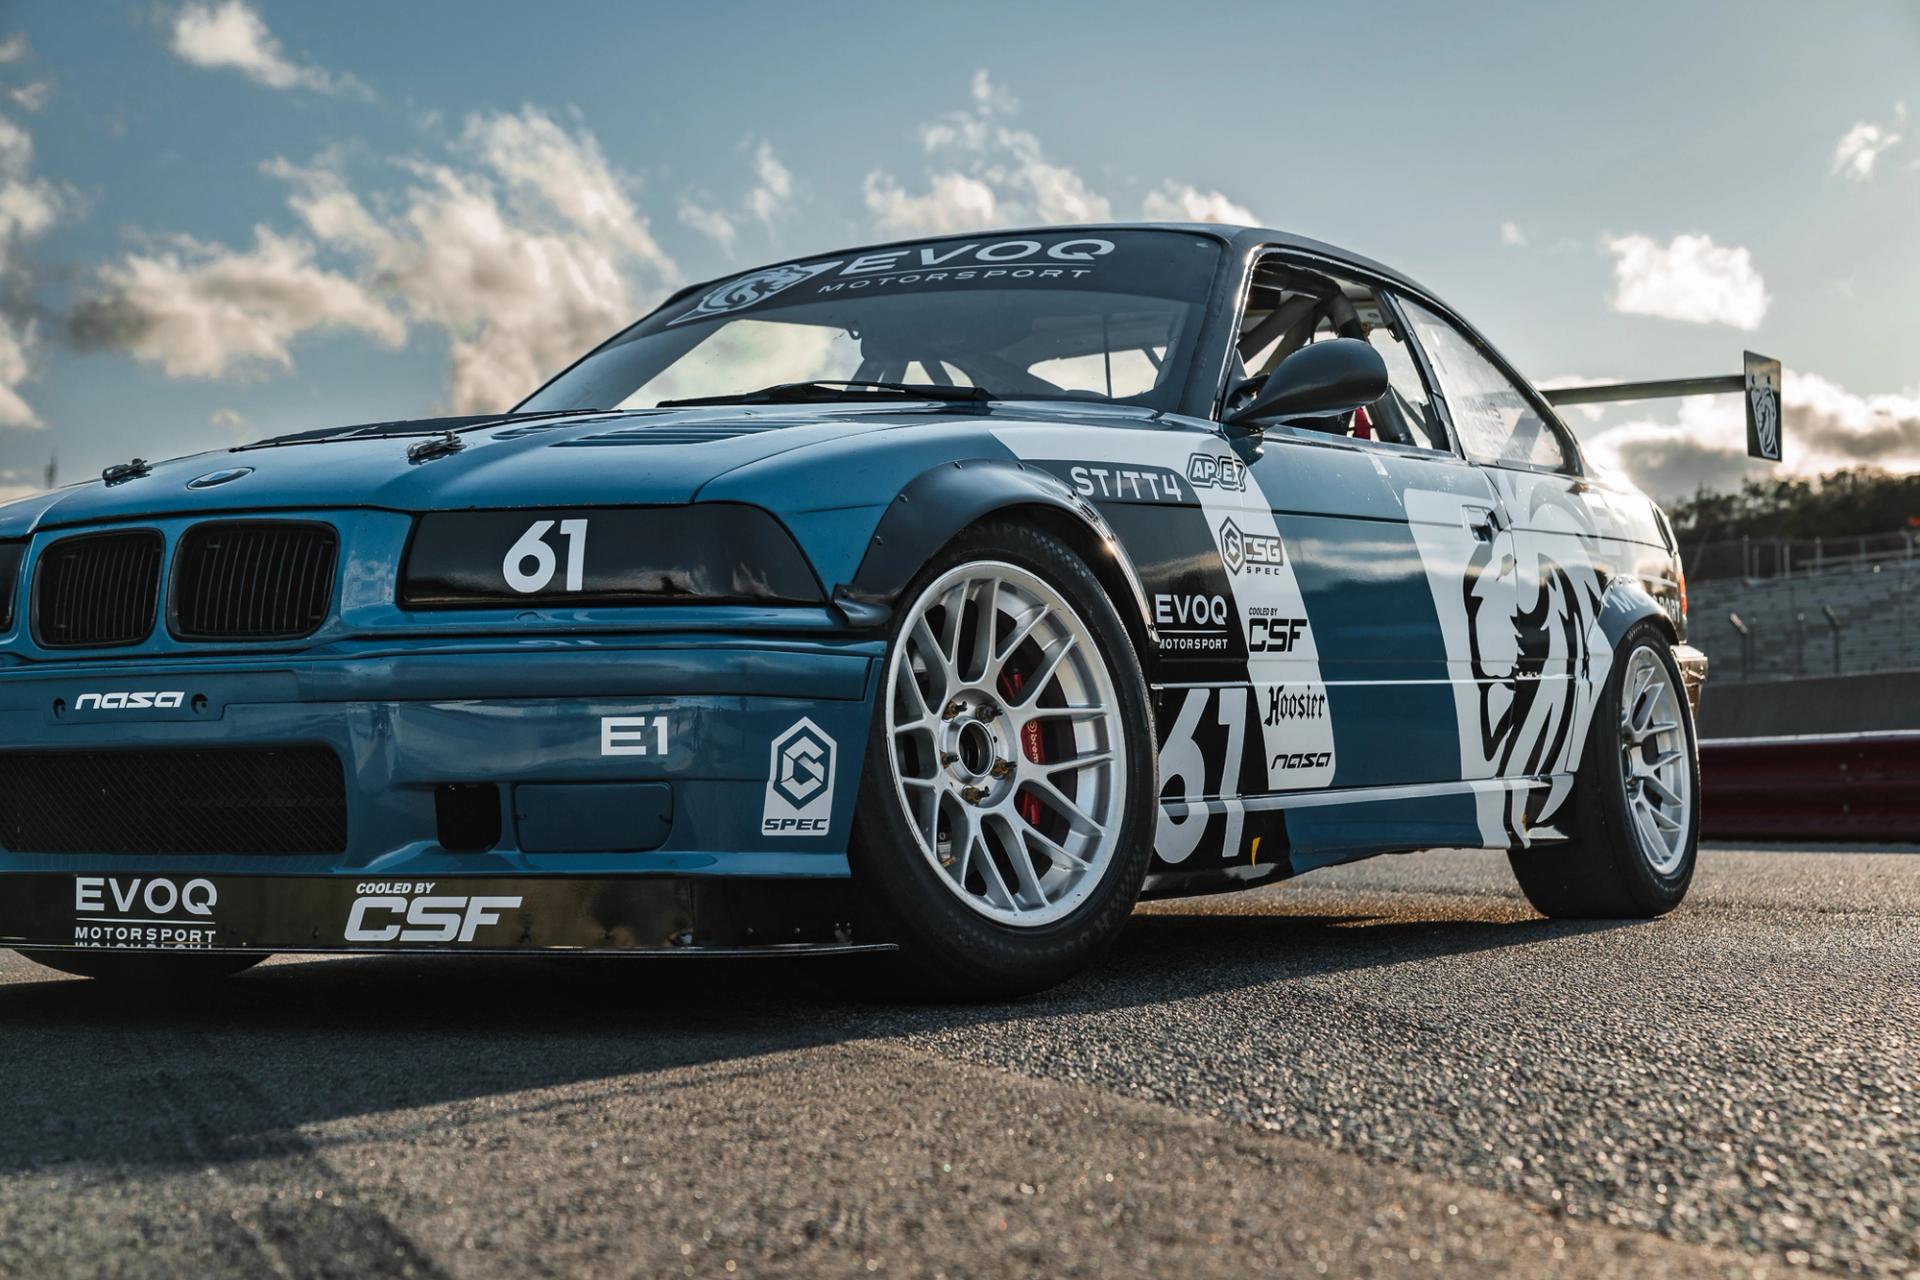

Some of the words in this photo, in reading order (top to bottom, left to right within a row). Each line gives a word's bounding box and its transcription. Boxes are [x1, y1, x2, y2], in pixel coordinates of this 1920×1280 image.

[838, 239, 1116, 276] EVOQ
[817, 269, 1092, 294] MOTORSPORT
[1070, 466, 1182, 501] ST/TT4
[502, 518, 588, 594] 61
[1246, 566, 1280, 576] SPEC
[1155, 594, 1228, 625] EVOQ
[1248, 607, 1270, 616] COOLED
[1271, 608, 1278, 616] BY
[1248, 618, 1307, 652] CSF
[75, 691, 185, 710] nasa
[1264, 684, 1326, 727] Hoosier
[601, 716, 668, 756] E1
[1153, 688, 1248, 864] 61
[1271, 752, 1332, 770] nasa
[764, 818, 829, 831] SPEC
[75, 877, 218, 915] EVOQ
[356, 882, 412, 894] COOLED
[414, 882, 435, 894] BY
[75, 926, 216, 943] MOTORSPORT
[344, 896, 523, 942] CSF
